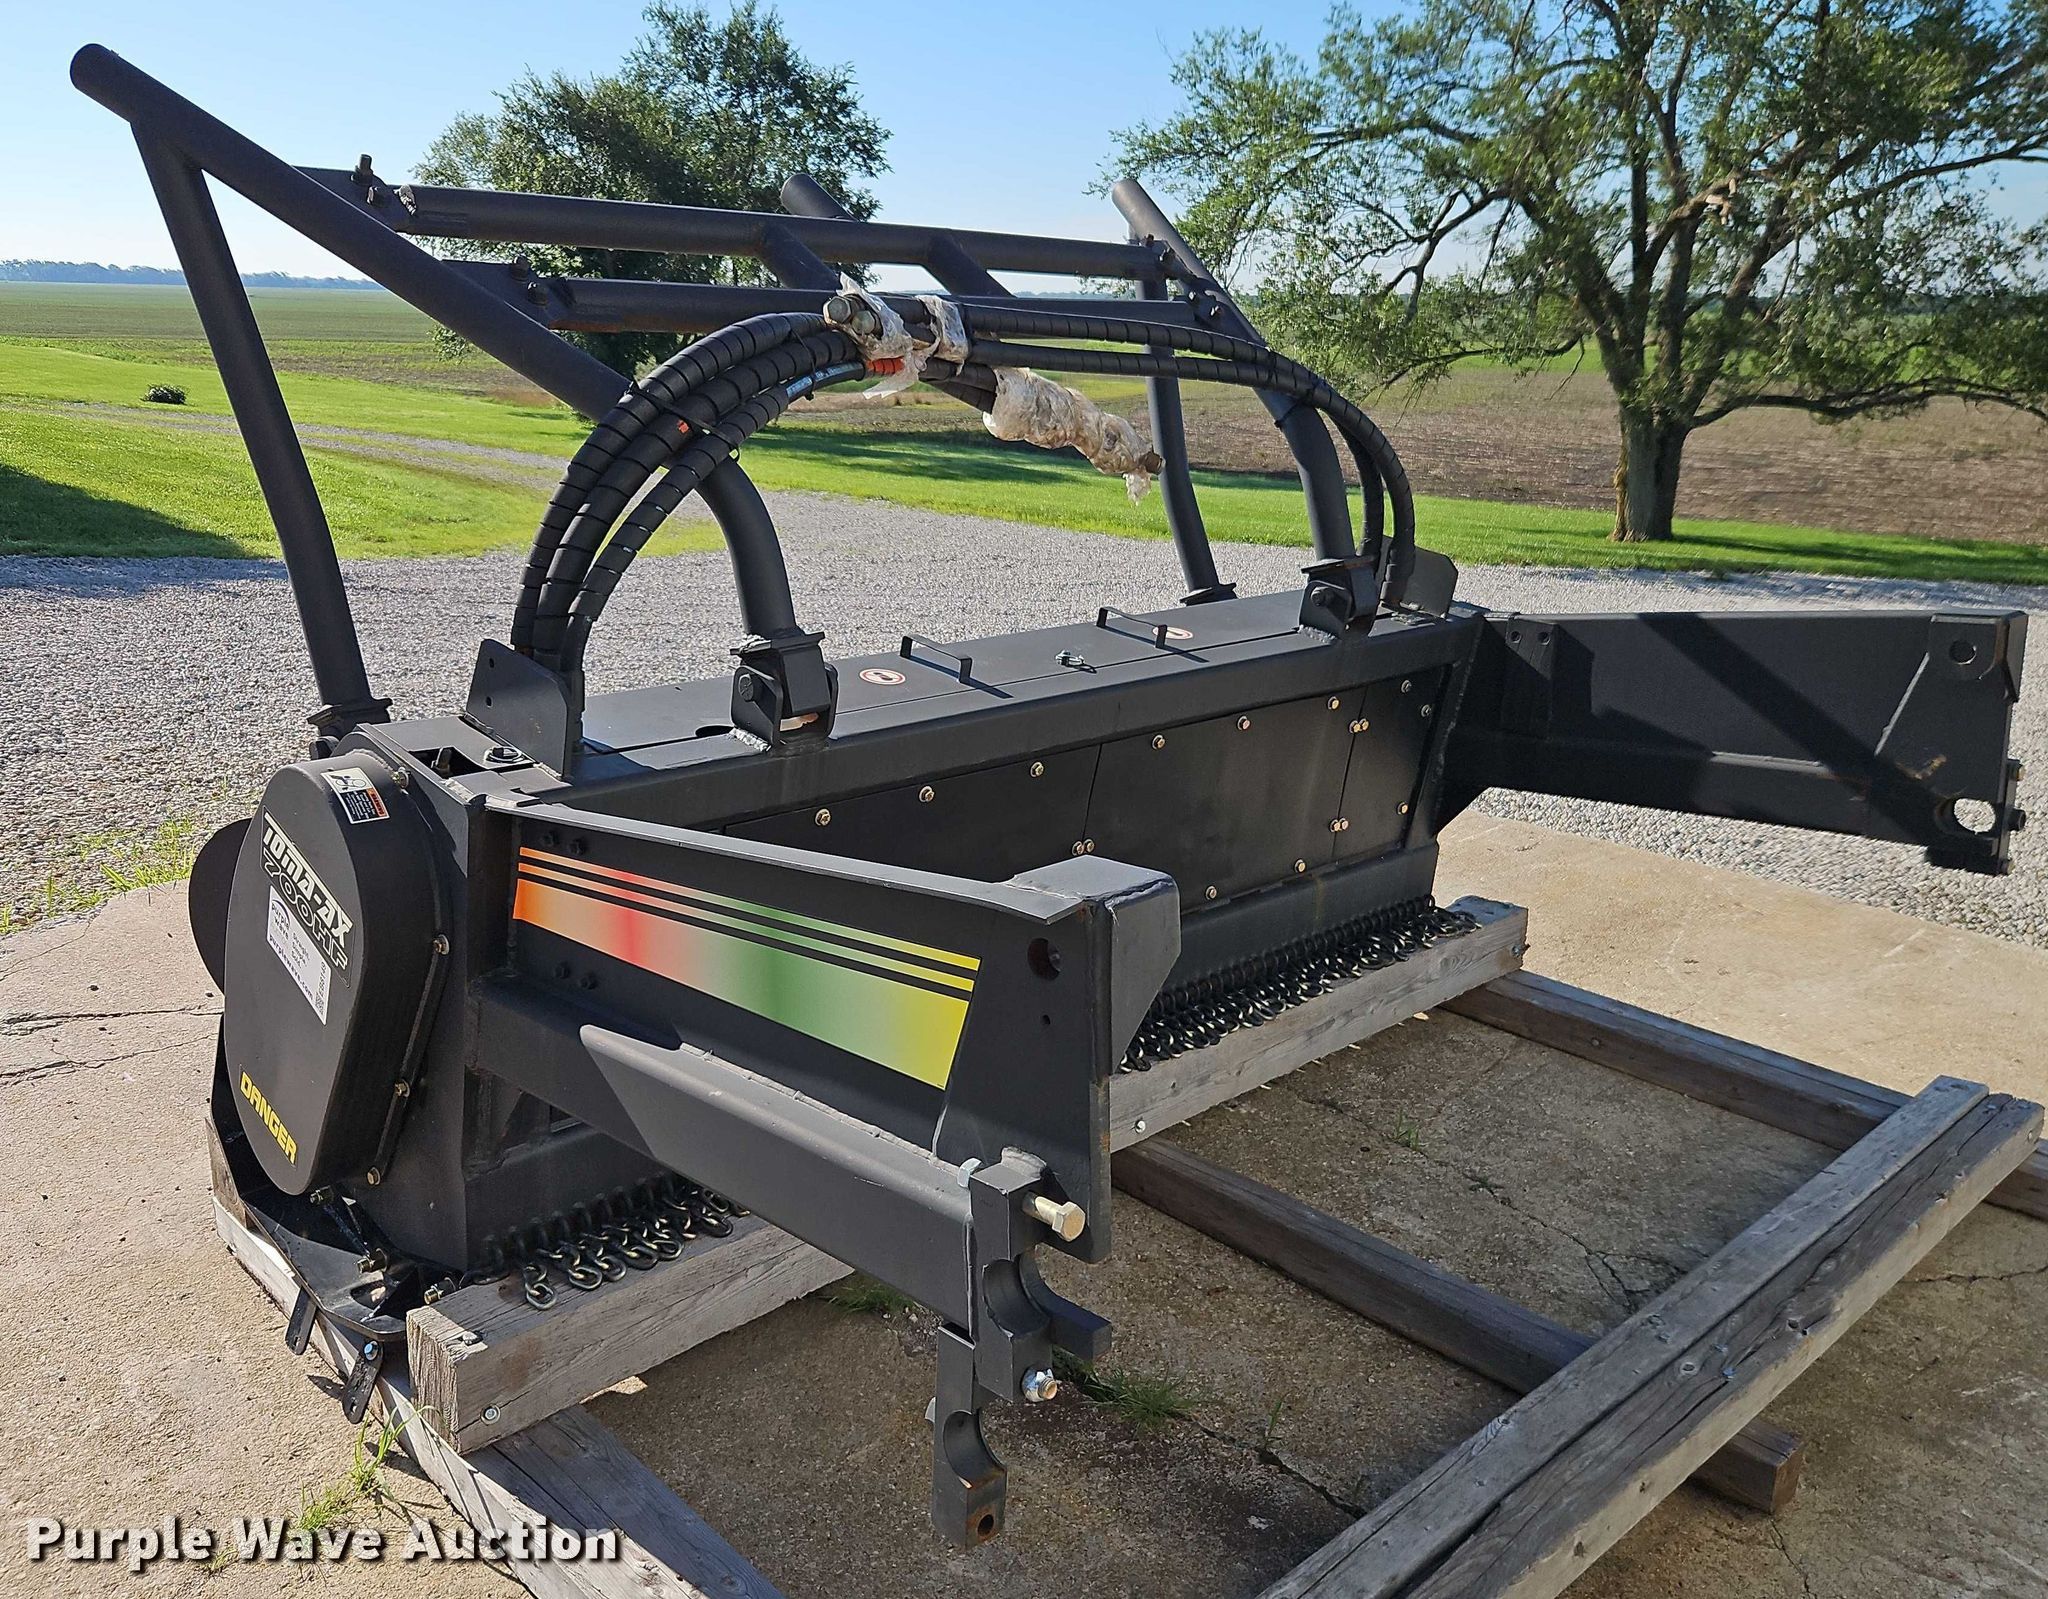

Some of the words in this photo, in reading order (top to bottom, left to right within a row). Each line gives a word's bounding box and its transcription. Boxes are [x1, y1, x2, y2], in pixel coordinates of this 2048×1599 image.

[262, 849, 348, 970] 700HF
[271, 902, 290, 931] purple
[274, 916, 289, 940] wave
[269, 934, 314, 1001] purplewave.com
[240, 1071, 298, 1165] DANGER
